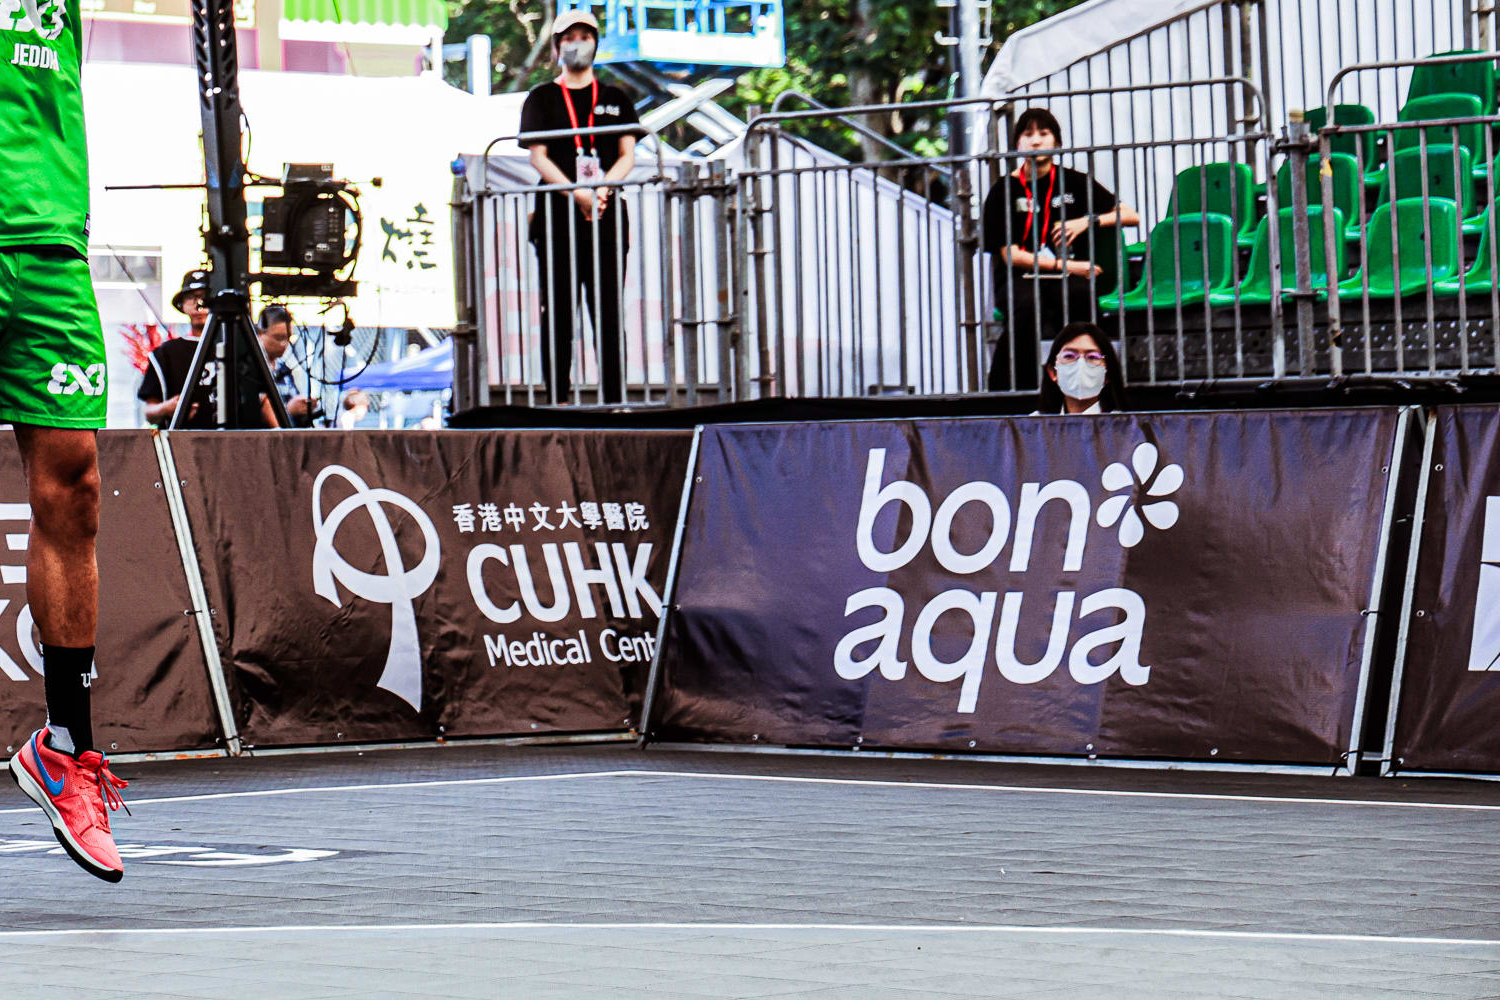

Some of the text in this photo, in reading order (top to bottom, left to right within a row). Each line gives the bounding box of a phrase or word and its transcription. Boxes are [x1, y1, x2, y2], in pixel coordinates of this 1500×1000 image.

[452, 500, 650, 532] 香港中文大學醫院
[856, 447, 1092, 575] bon
[466, 541, 664, 624] CUHK
[483, 629, 592, 667] Medical
[833, 586, 1151, 714] aqua
